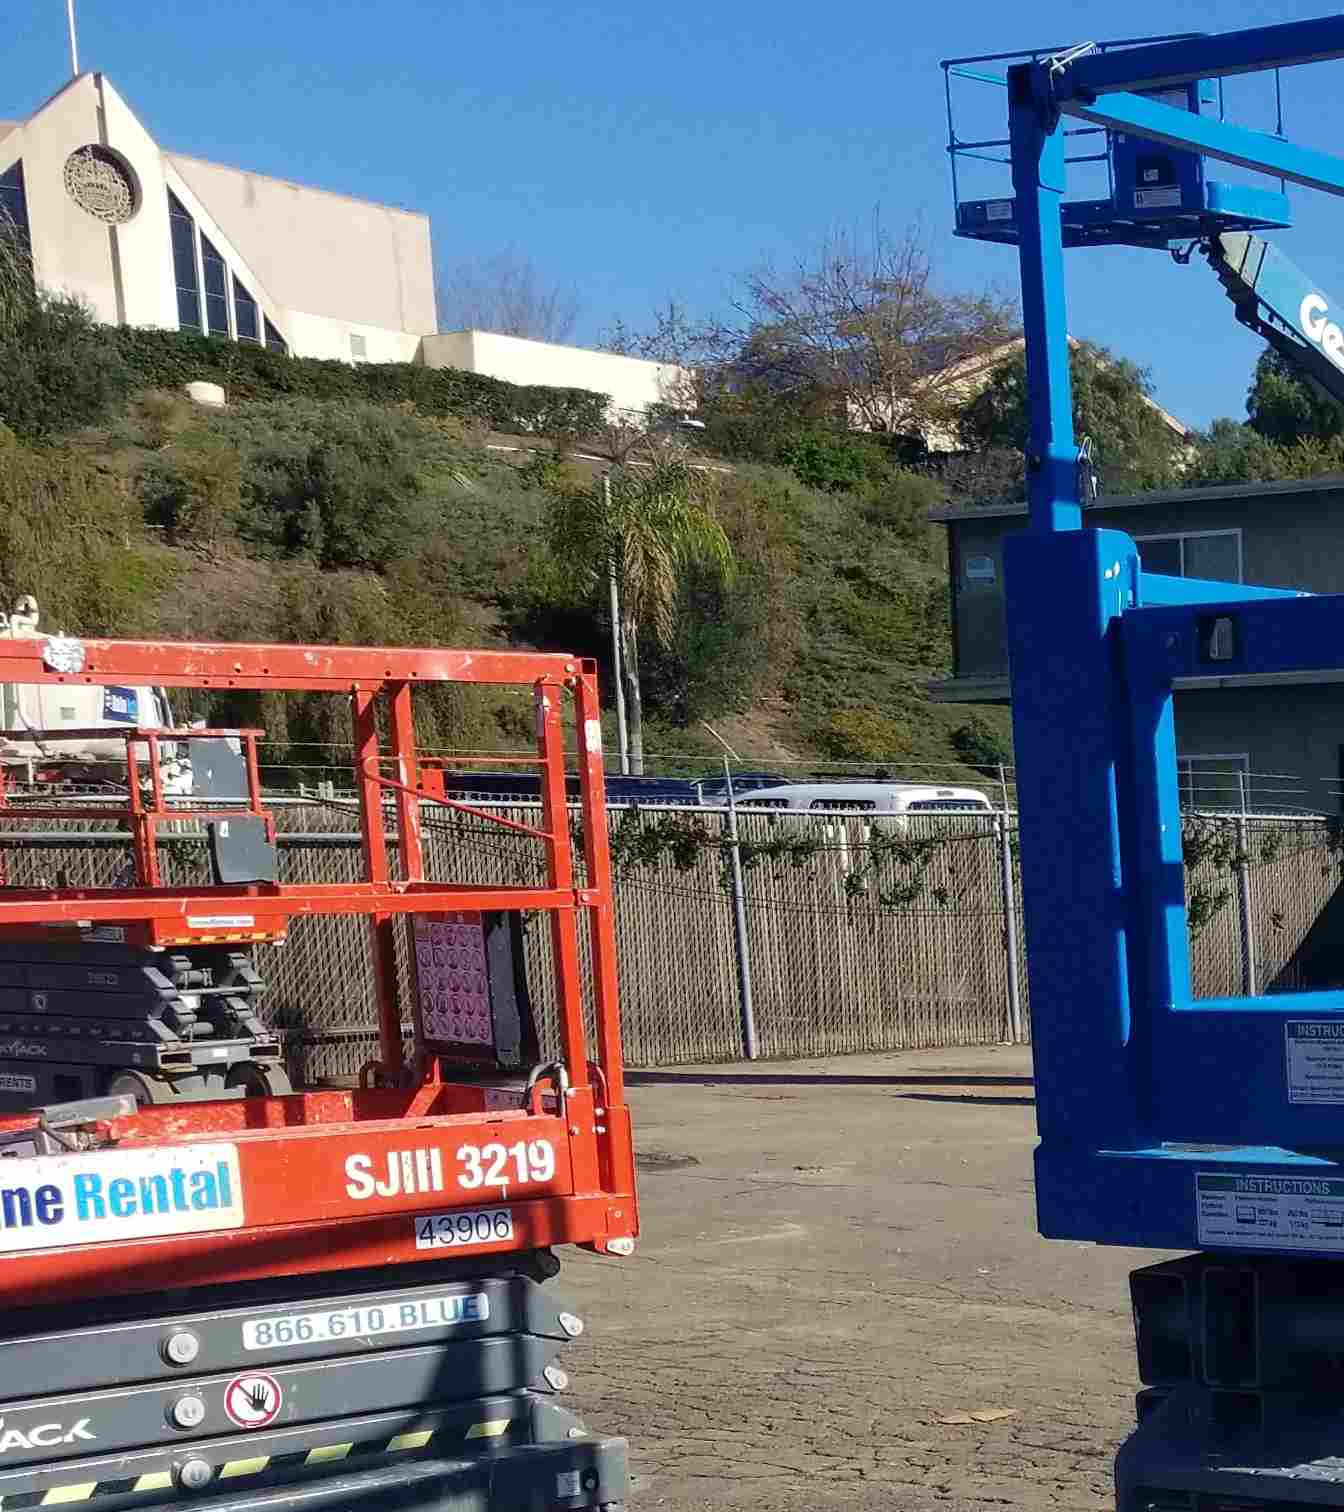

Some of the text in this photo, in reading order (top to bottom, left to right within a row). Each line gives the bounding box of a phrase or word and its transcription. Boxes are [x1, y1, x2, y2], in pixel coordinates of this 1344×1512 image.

[73, 1161, 233, 1222] Rental
[344, 1140, 556, 1200] SJIII 3219
[1232, 1178, 1331, 1195] INSTRUCTIONS
[418, 1211, 511, 1246] 43906
[254, 1295, 480, 1346] 866.610.BLUE
[0, 1416, 97, 1452] ACK
